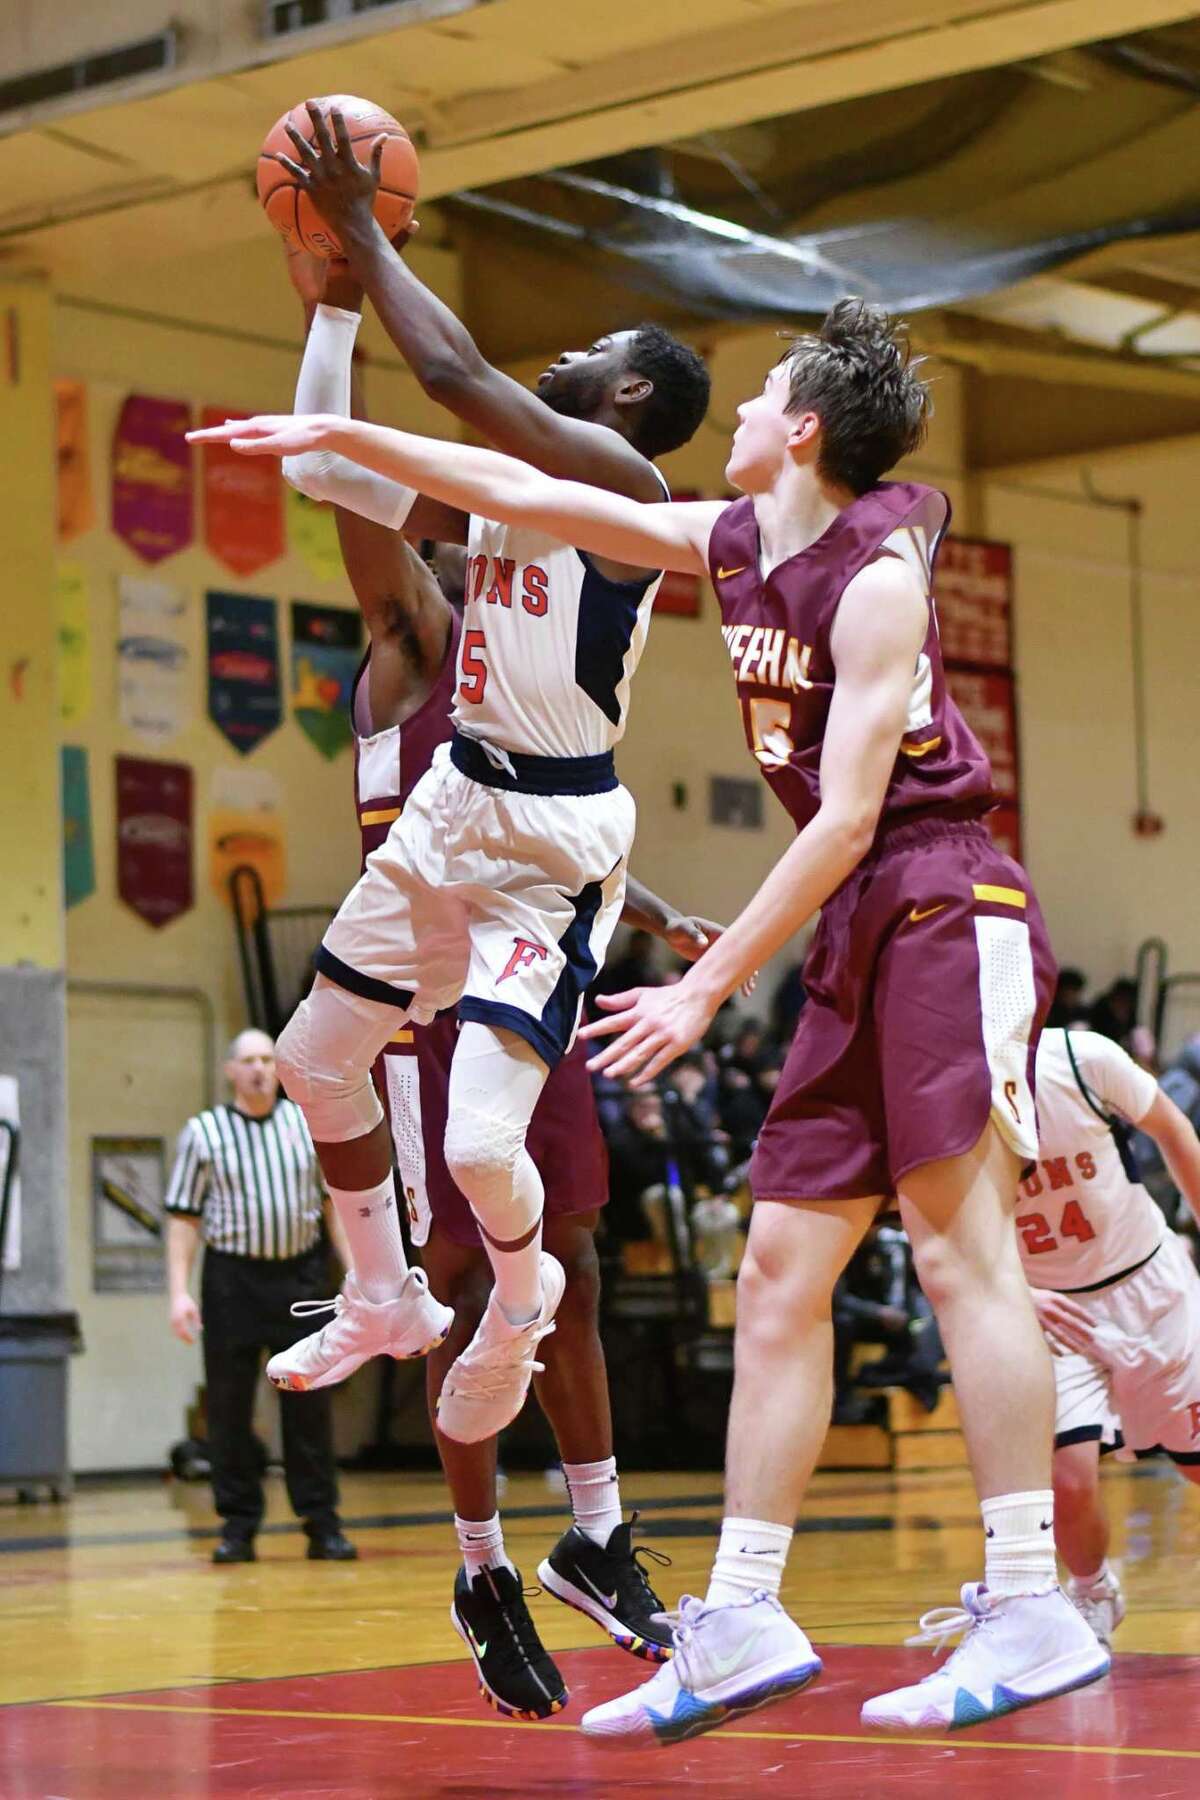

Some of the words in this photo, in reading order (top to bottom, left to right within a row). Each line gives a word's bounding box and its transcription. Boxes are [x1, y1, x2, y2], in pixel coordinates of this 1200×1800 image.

[460, 630, 487, 704] 5
[495, 936, 548, 985] F
[1015, 1151, 1097, 1202] ONS
[1015, 1199, 1096, 1255] 24
